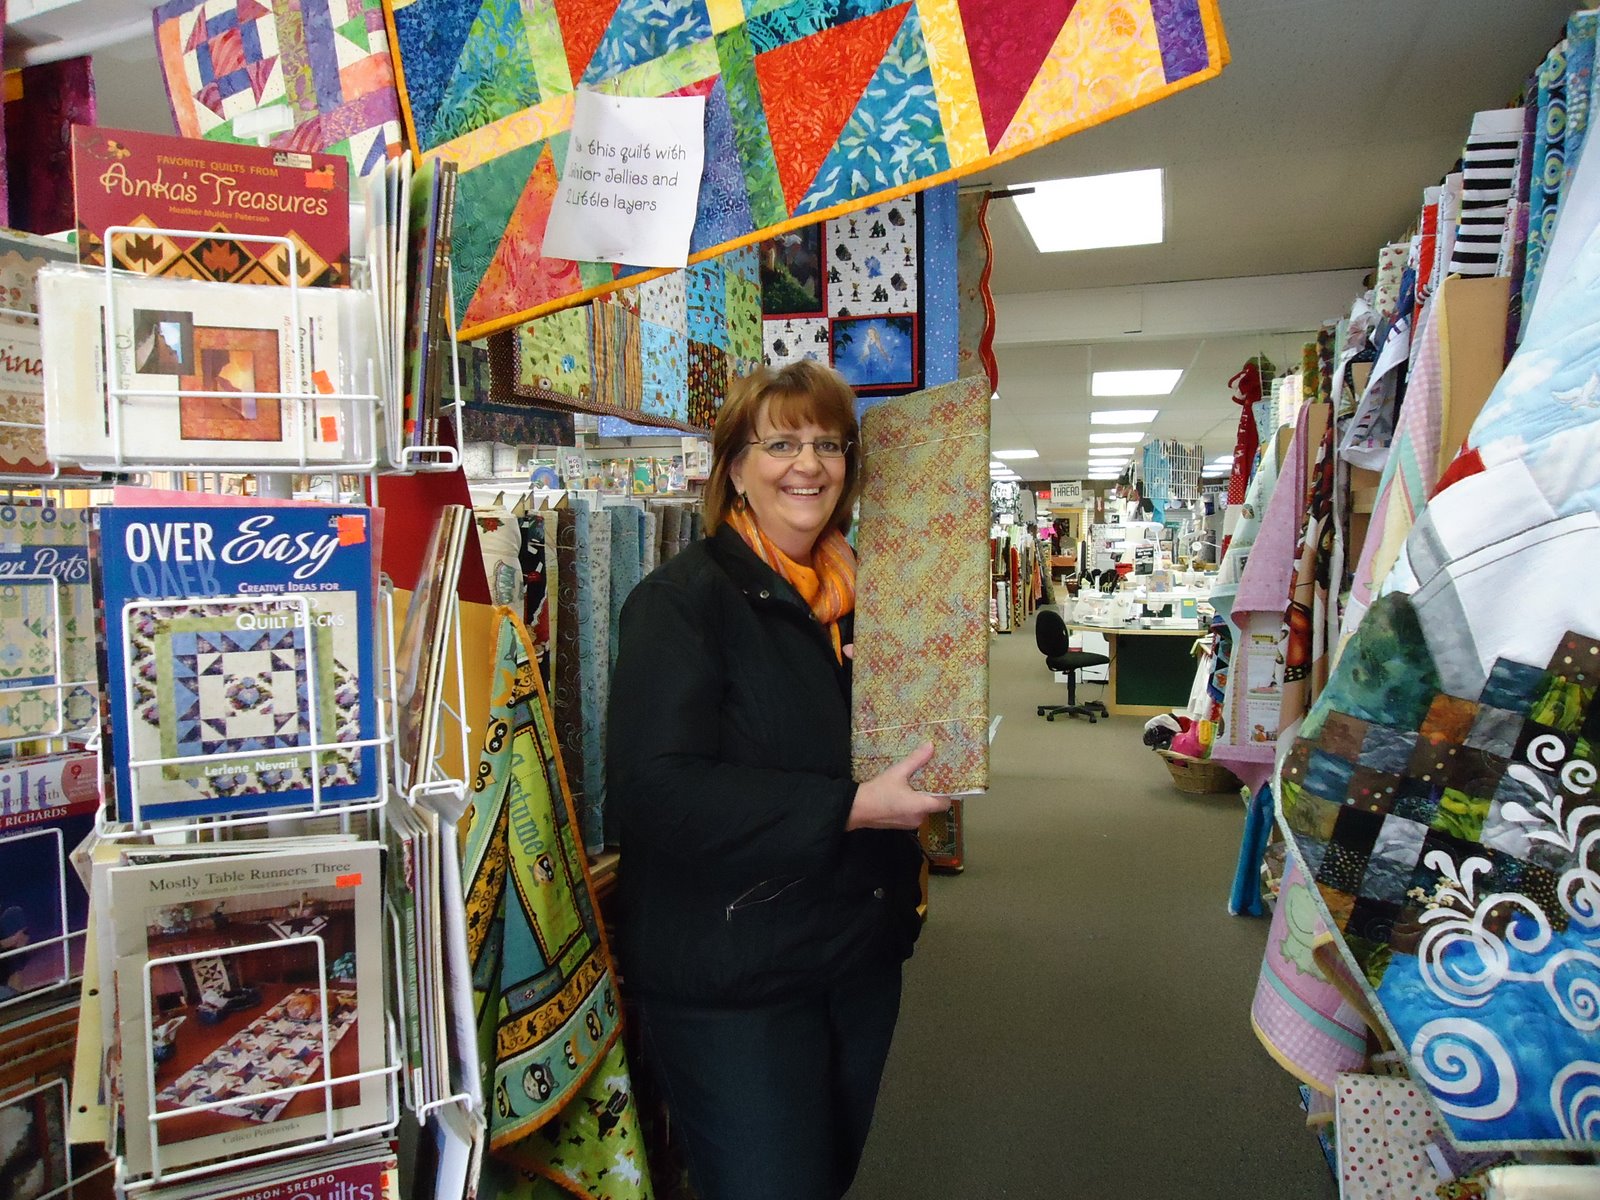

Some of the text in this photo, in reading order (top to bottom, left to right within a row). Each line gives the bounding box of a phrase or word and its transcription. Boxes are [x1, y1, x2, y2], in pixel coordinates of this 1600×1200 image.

[588, 139, 616, 157] this
[620, 143, 650, 163] quilt
[655, 145, 686, 160] with
[157, 155, 279, 178] FAVORITE QUILTS FROM
[605, 168, 648, 185] Jellies
[652, 171, 679, 187] and
[99, 162, 329, 217] Anka's Treasures
[613, 194, 657, 214] layers
[1053, 486, 1080, 497] THREAD
[1202, 485, 1227, 493] OTIONS
[125, 514, 341, 580] OVER Easy
[33, 547, 88, 582] Pots
[255, 757, 299, 771] Nevaril
[0, 769, 54, 816] ilt
[5, 806, 67, 827] RICHARDS
[149, 876, 200, 893] Mostly
[205, 870, 245, 885] Table
[250, 865, 308, 880] Runners
[311, 862, 351, 874] Three
